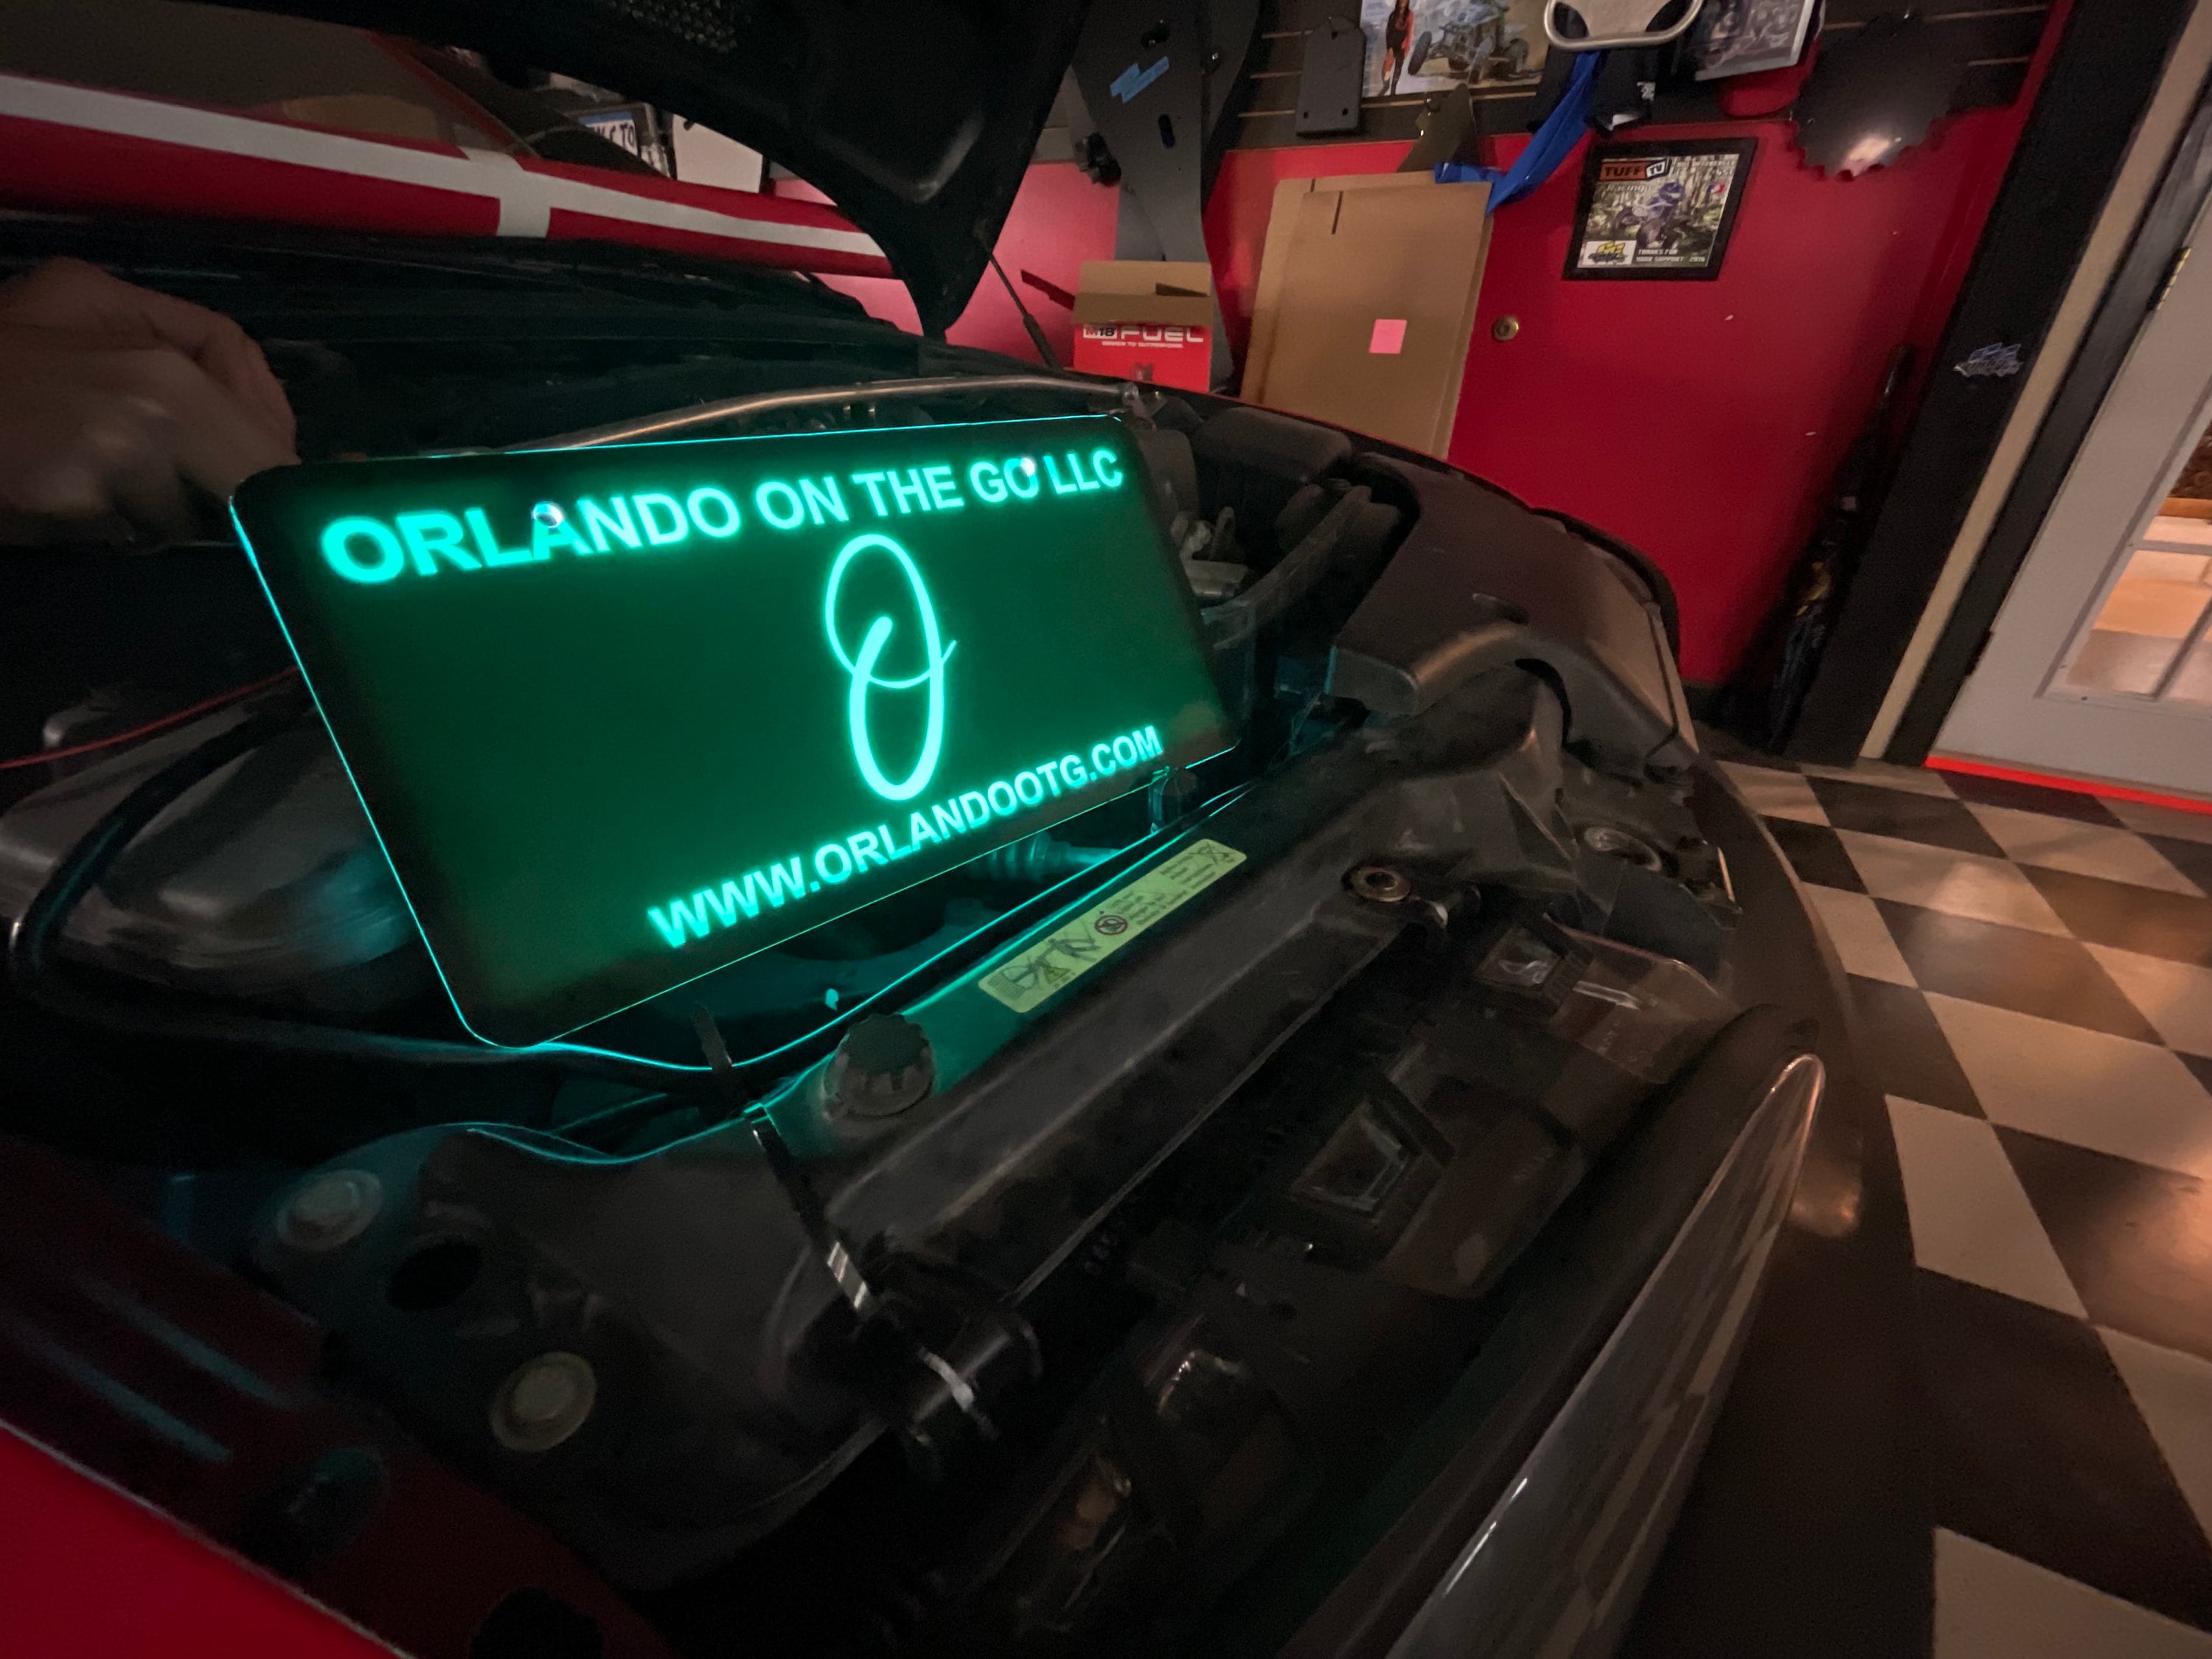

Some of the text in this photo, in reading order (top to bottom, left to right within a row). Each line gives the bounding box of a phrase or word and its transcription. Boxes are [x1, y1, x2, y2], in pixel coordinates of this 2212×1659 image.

[1604, 165, 1641, 177] TUFF
[1606, 183, 1645, 194] Racing
[1121, 326, 1203, 342] FUEL
[320, 448, 1124, 583] ORLANDO ON THE GO LLC
[647, 724, 1164, 948] WWW.ORLANDOOTG.COM
